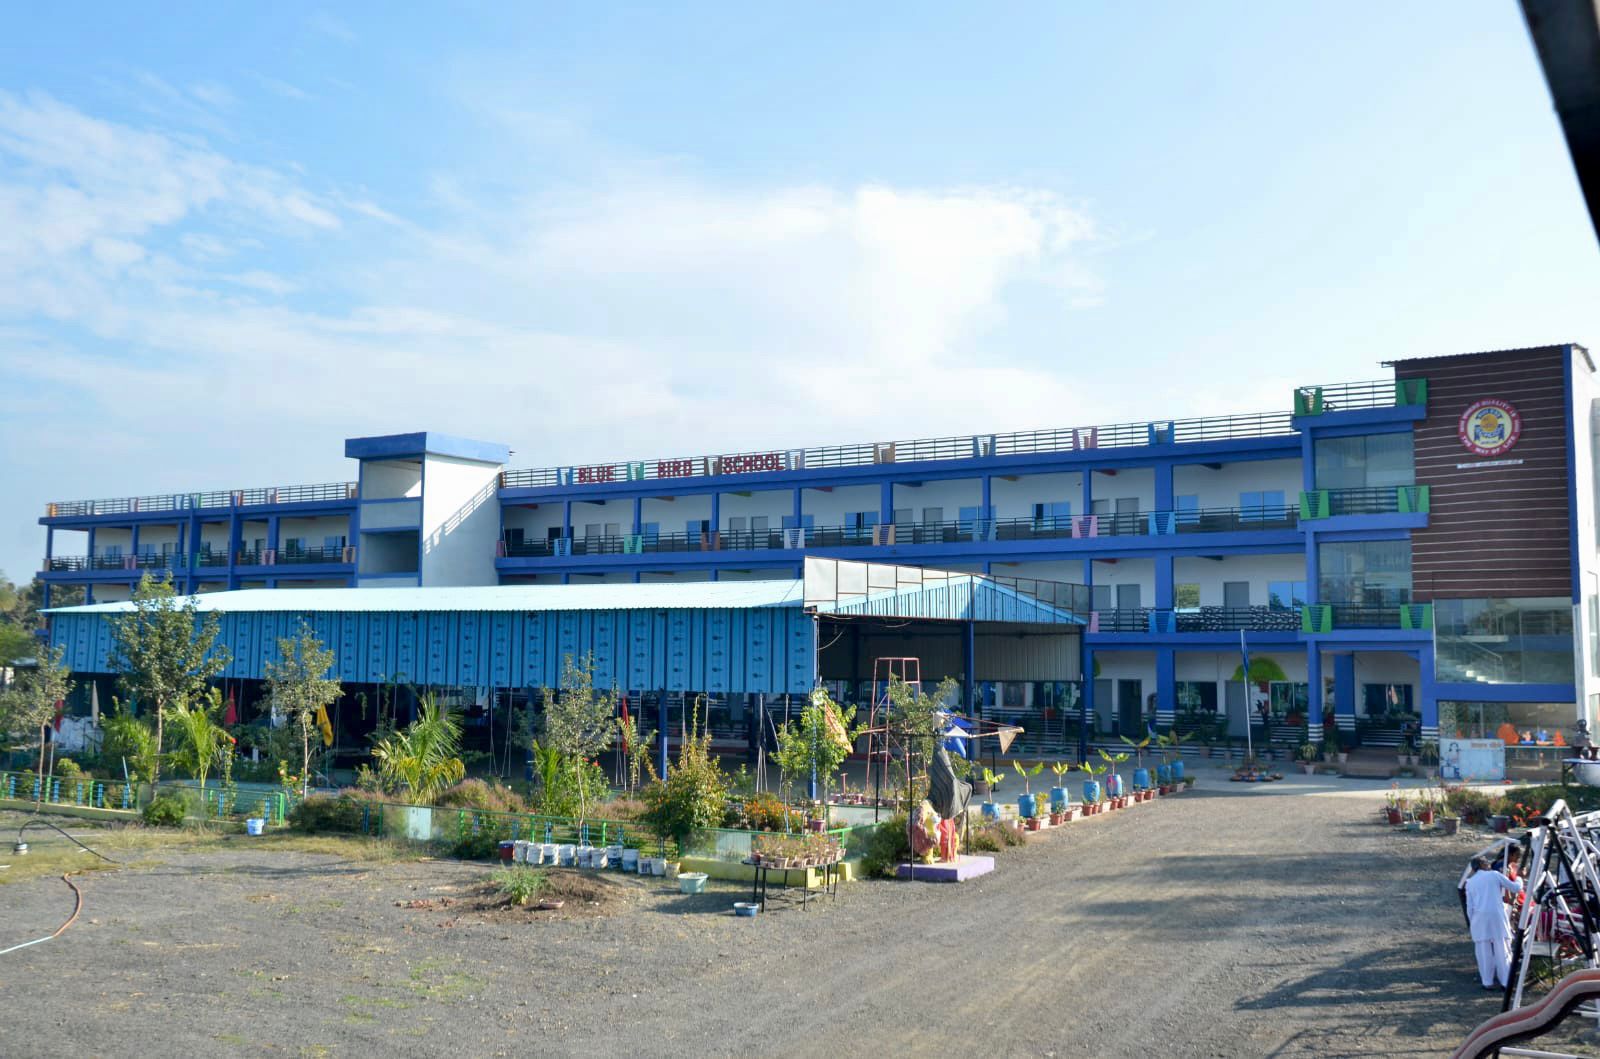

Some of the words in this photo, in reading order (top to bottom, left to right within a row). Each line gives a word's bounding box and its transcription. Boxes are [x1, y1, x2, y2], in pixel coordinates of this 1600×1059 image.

[578, 465, 615, 483] BLUE
[657, 460, 692, 478] BIRD
[722, 454, 785, 474] SCHOOL
